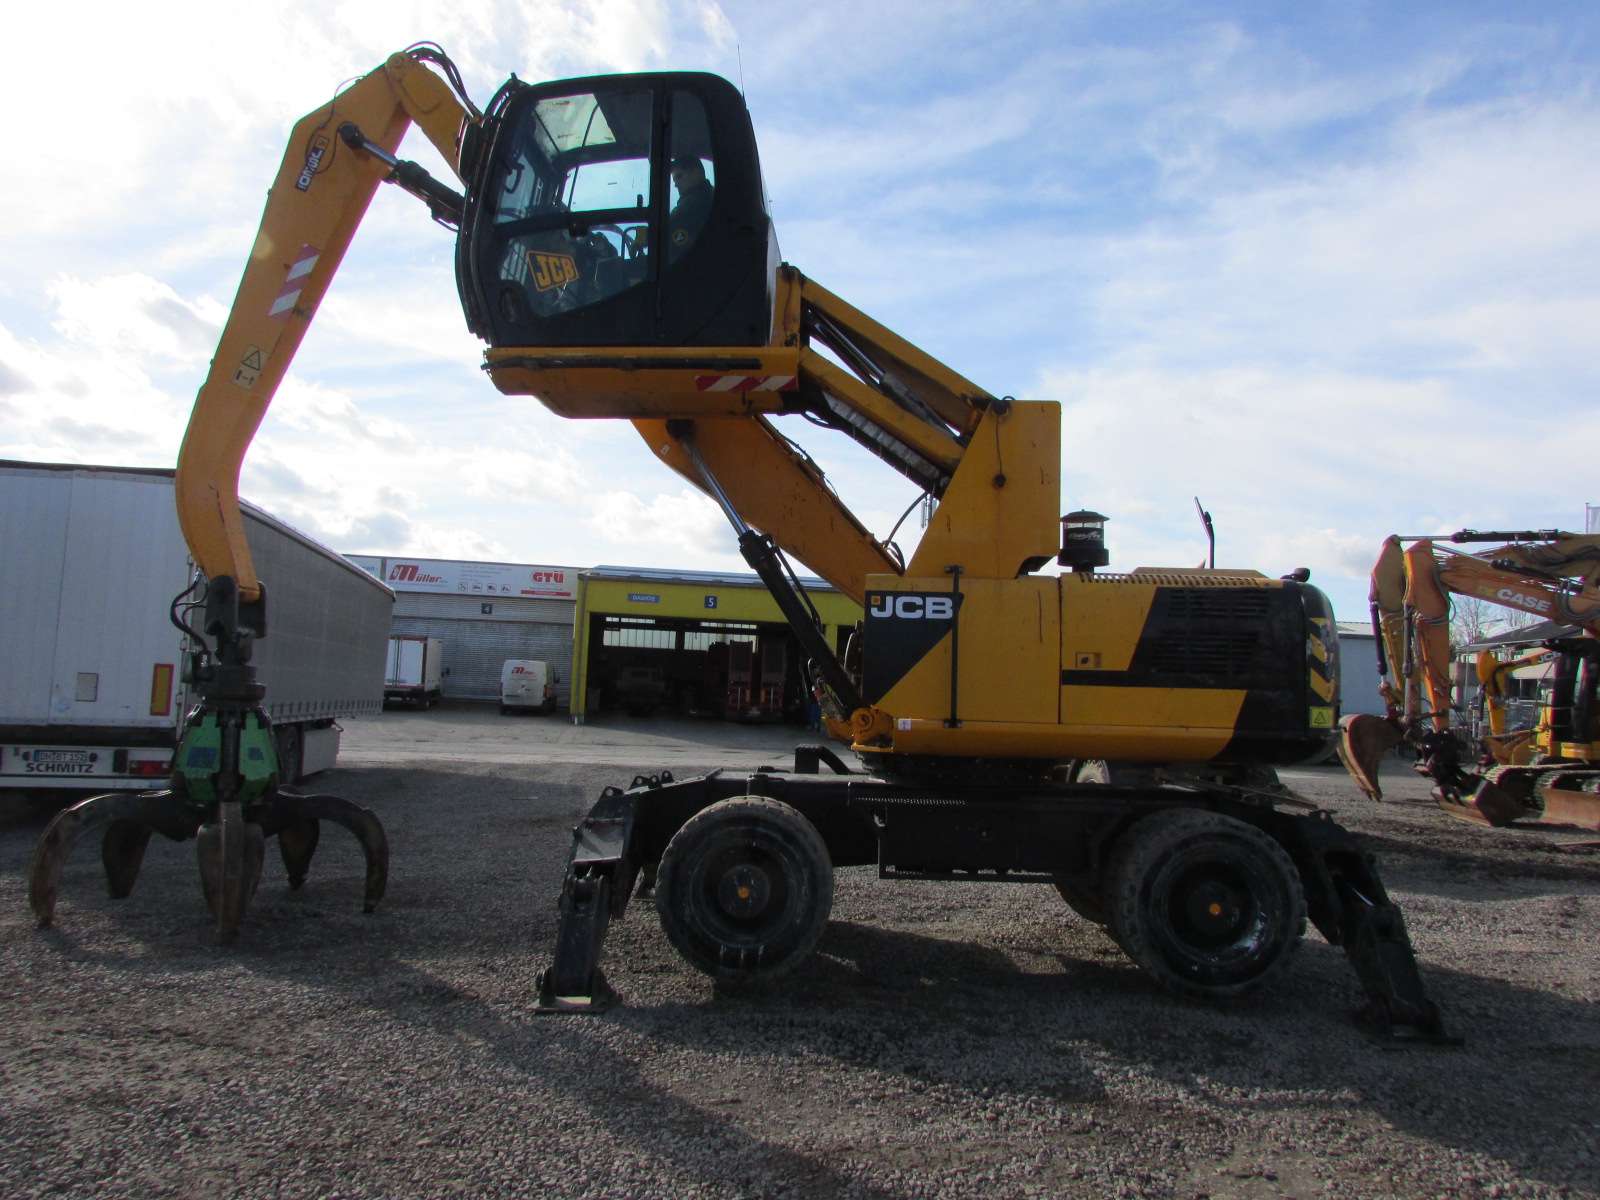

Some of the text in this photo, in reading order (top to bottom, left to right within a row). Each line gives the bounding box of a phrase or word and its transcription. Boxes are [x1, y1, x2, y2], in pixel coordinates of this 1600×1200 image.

[535, 255, 575, 287] JCB
[532, 570, 564, 583] GTÜ
[870, 595, 953, 619] JCB
[1496, 588, 1551, 612] CASE
[56, 753, 67, 761] BT
[69, 753, 85, 761] 152
[26, 762, 94, 773] SCHMITZ
